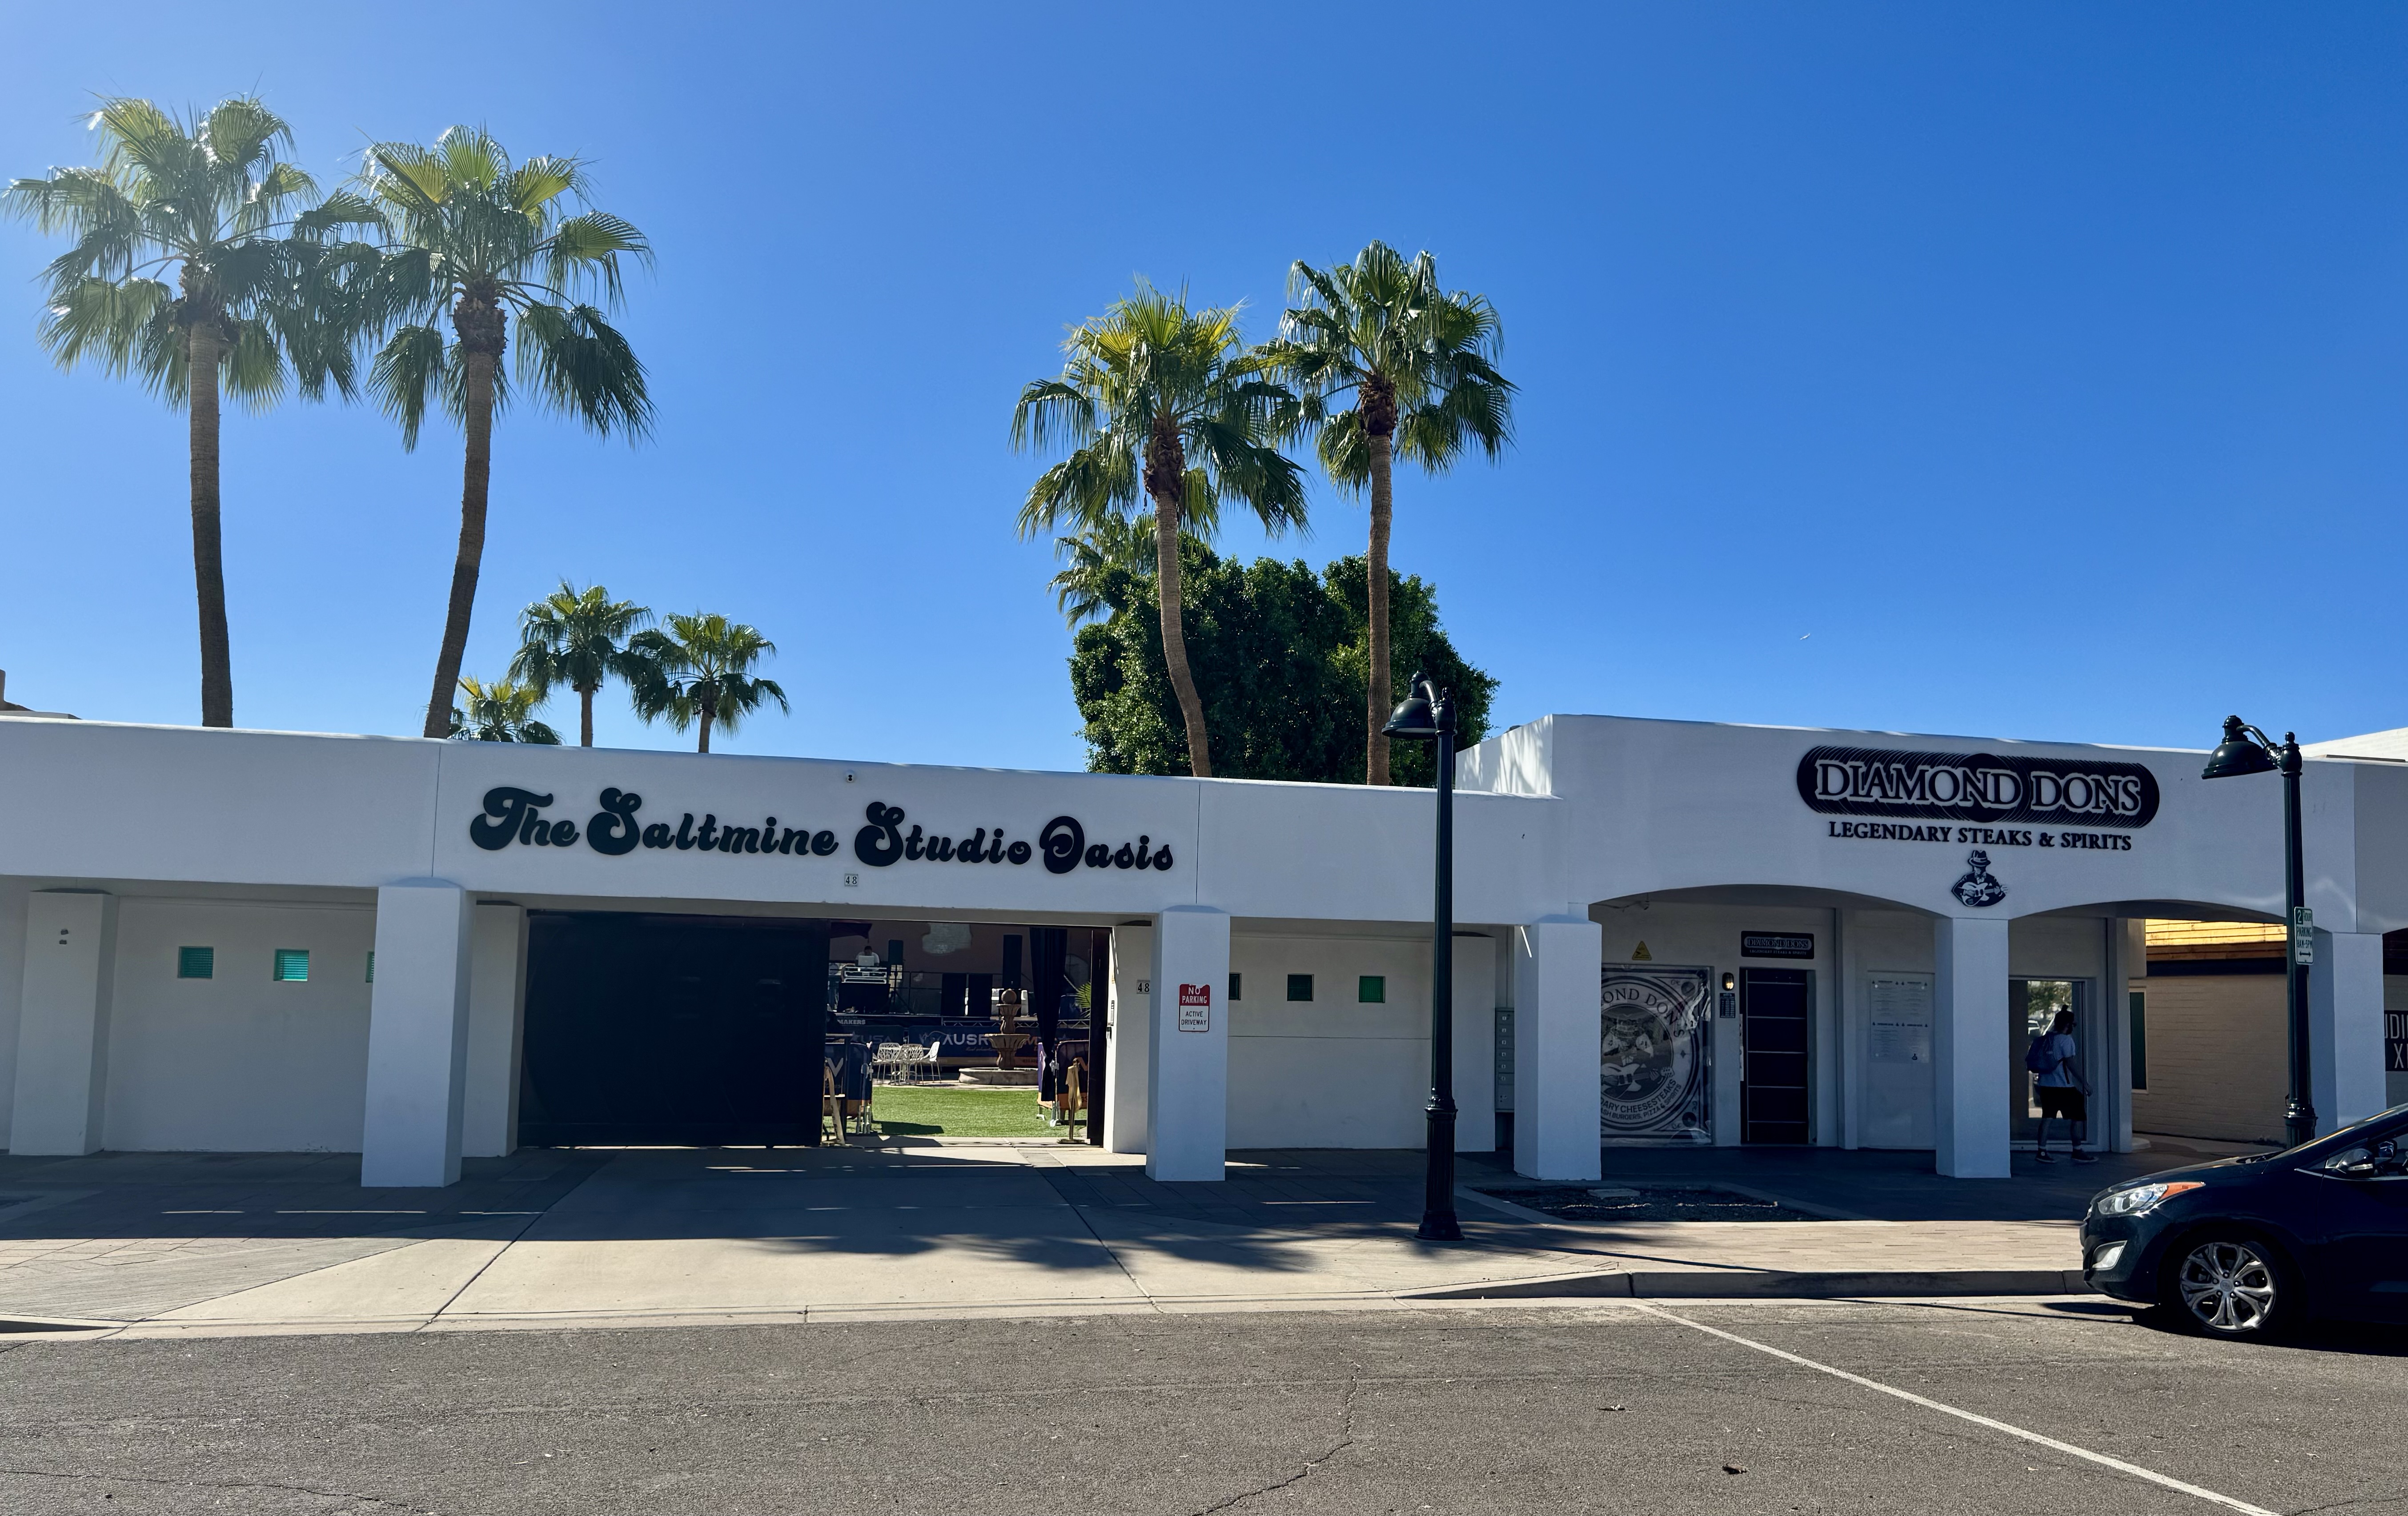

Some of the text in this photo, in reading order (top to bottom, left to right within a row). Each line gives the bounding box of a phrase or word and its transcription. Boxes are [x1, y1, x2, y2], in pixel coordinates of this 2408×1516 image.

[1818, 762, 2141, 812] DIAMOND DONS
[470, 787, 1174, 874] The Saltmine Studio Oasis
[1829, 821, 2132, 851] LEGENDARY STEAKS & SPIRITS
[846, 875, 858, 885] 48
[2297, 909, 2302, 923] 2
[2297, 926, 2312, 937] PARKING
[1747, 938, 1808, 948] DIAMOND DONS
[1137, 983, 1150, 992] 48
[1188, 987, 1200, 995] NO
[1182, 995, 1207, 1004] PARKING
[1644, 993, 1685, 1037] DONS
[1620, 1079, 1676, 1113] CHEESESTEAKS
[1643, 1106, 1661, 1117] PIZZA
[1664, 1083, 1682, 1105] SPIRITS
